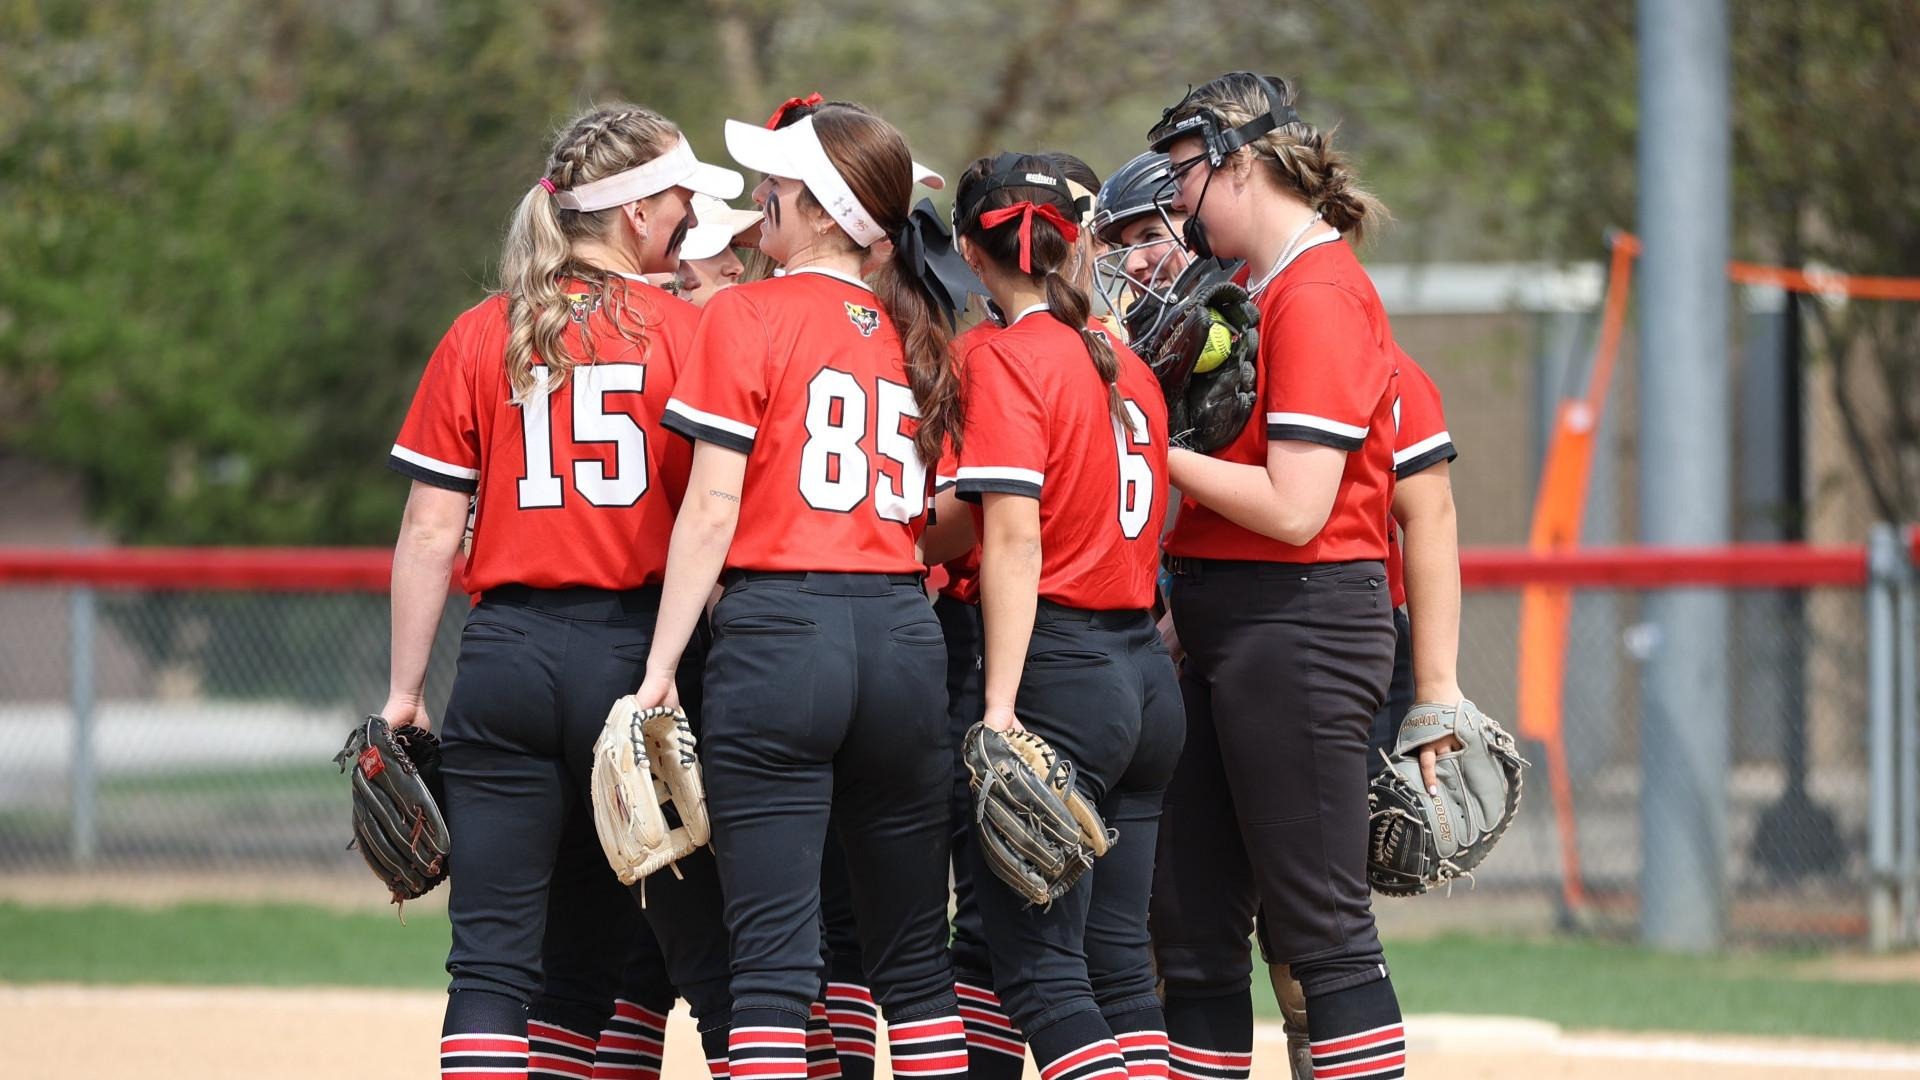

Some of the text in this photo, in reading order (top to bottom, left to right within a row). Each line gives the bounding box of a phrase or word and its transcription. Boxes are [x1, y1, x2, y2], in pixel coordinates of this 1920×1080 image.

[511, 363, 649, 510] 15
[798, 365, 928, 525] 85
[1110, 398, 1154, 540] 6
[1432, 796, 1451, 842] A2000
